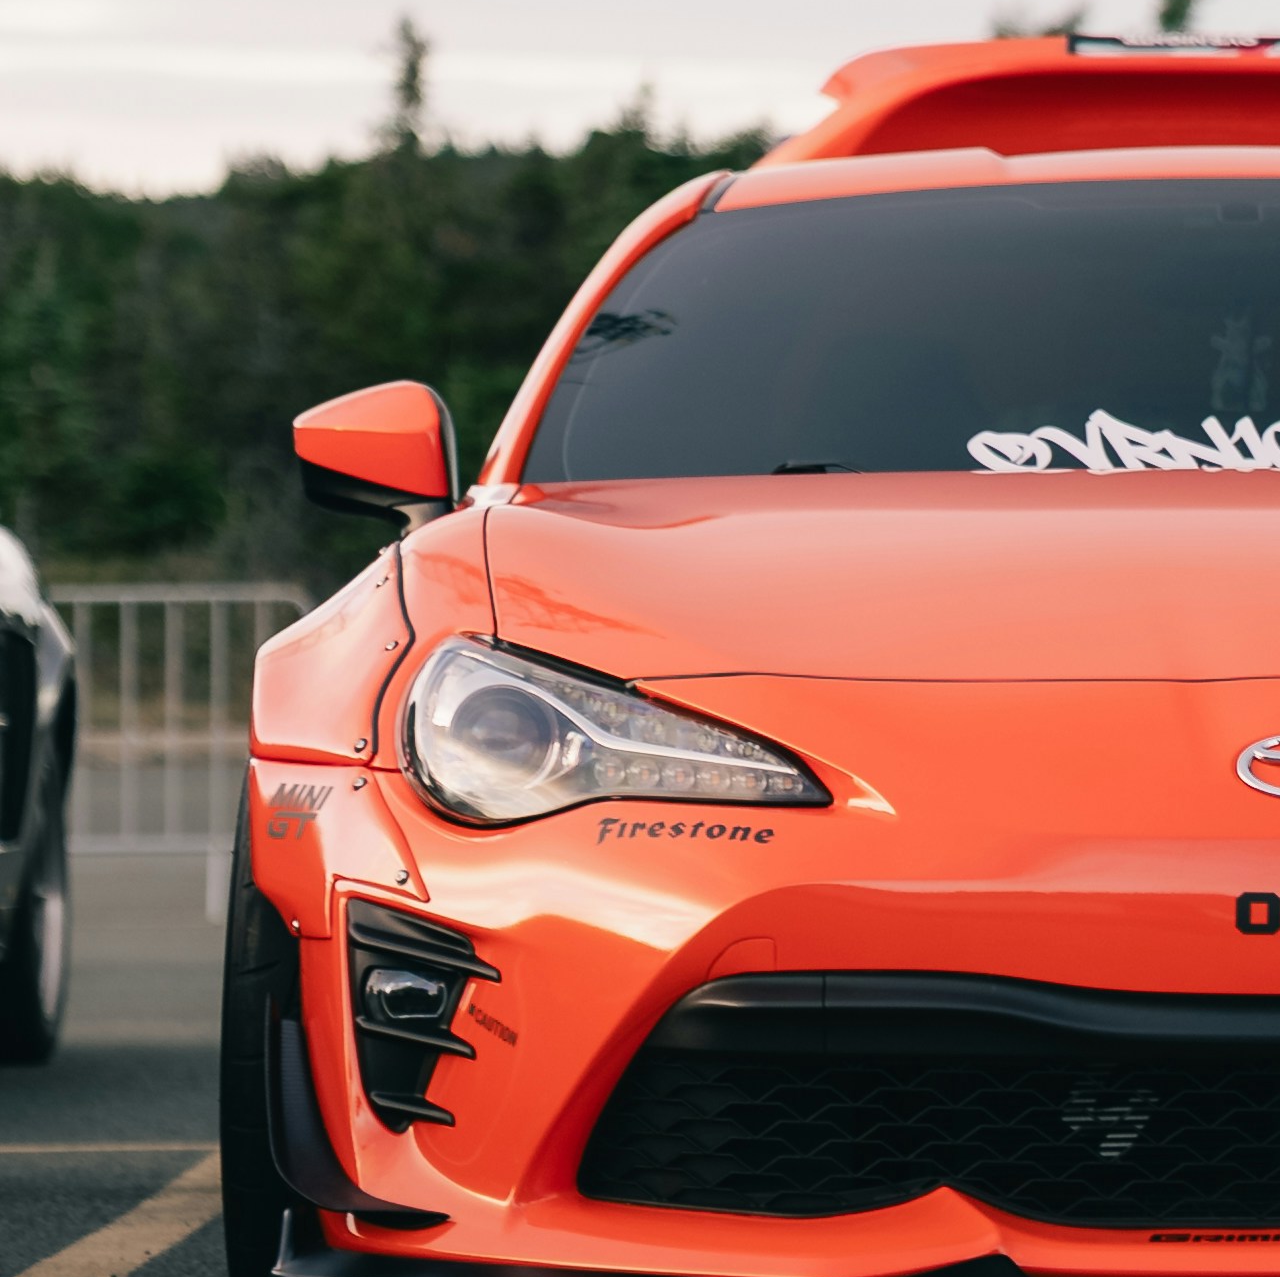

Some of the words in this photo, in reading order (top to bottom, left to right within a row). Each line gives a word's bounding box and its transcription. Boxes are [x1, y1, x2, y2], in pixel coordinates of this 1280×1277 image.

[269, 783, 334, 811] MINI
[267, 811, 318, 840] GT
[597, 818, 775, 844] Firestone
